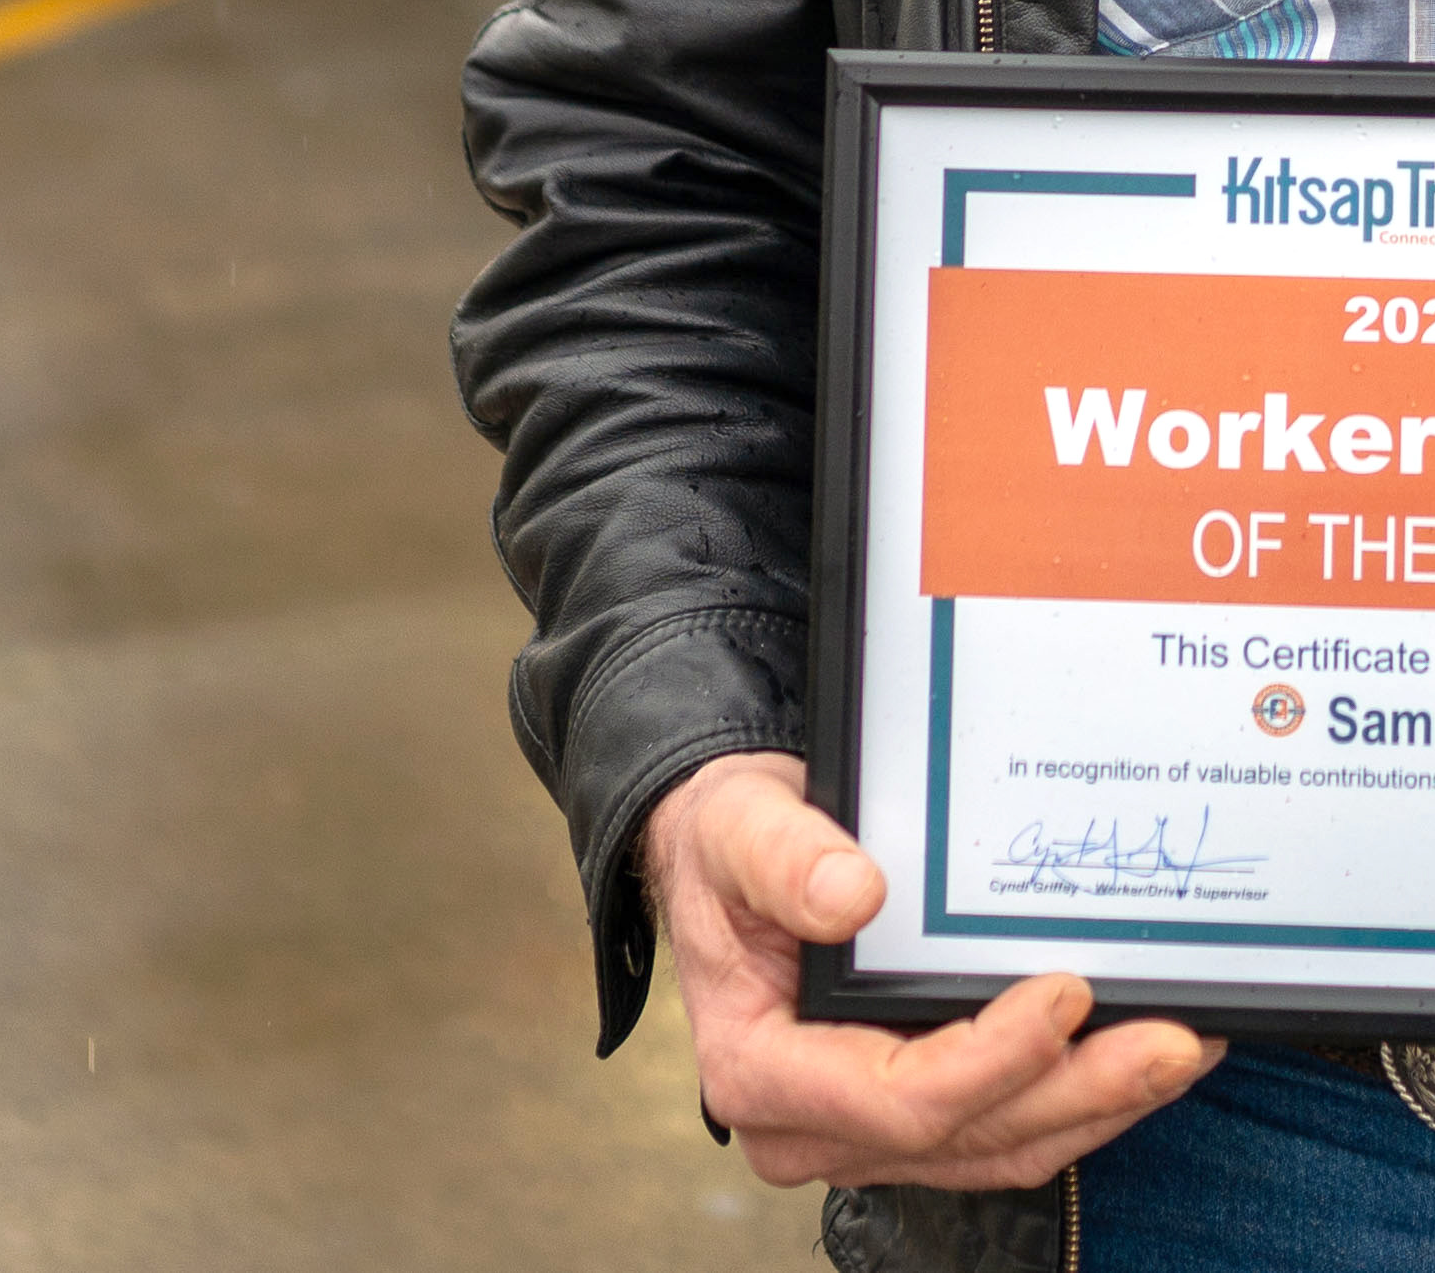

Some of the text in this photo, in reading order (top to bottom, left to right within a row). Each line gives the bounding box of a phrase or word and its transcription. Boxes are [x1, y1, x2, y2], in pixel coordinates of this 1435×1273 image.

[1192, 509, 1286, 578] OF
[1151, 633, 1228, 667] This
[1242, 635, 1430, 675] Certificate
[1327, 695, 1432, 745] Sam
[1008, 756, 1027, 778] in
[1035, 758, 1160, 785] recognition
[1168, 761, 1190, 782] of
[1196, 762, 1291, 786] valuable
[1194, 887, 1269, 902] Supervisor
